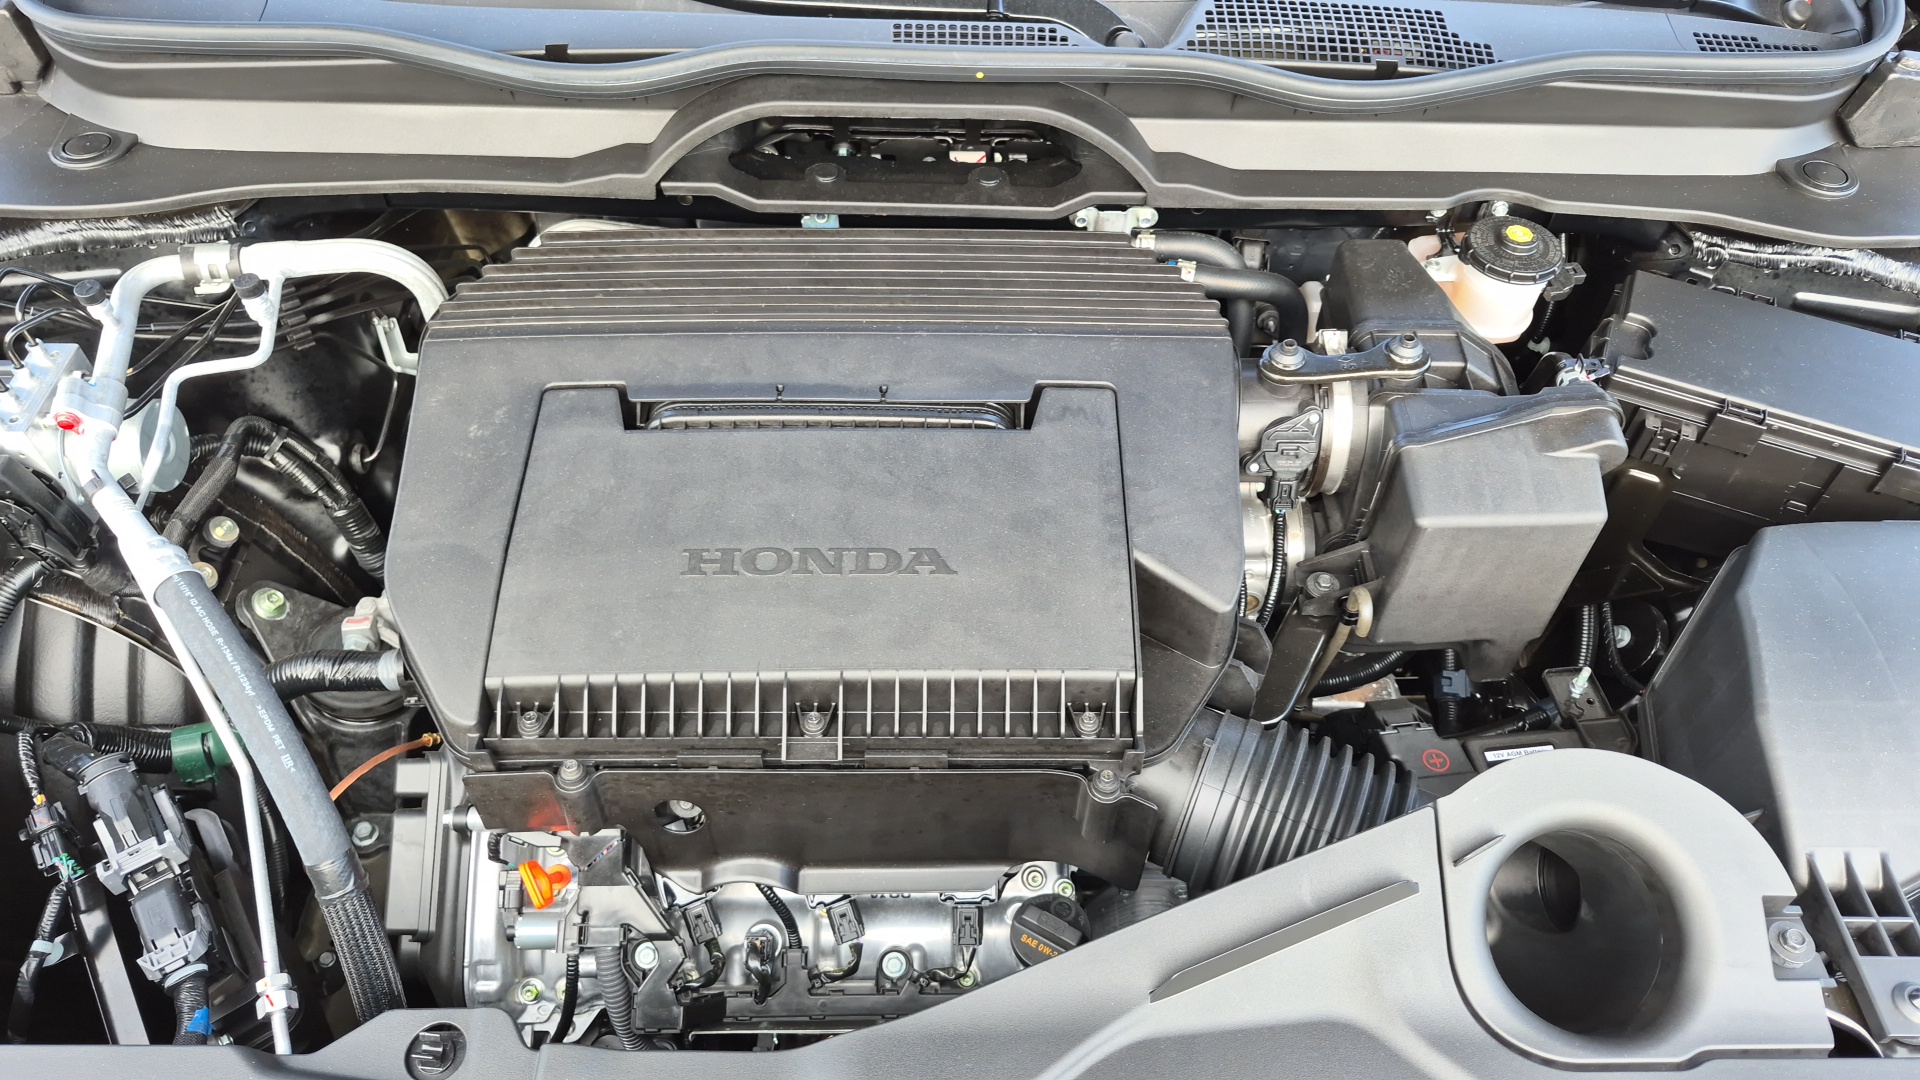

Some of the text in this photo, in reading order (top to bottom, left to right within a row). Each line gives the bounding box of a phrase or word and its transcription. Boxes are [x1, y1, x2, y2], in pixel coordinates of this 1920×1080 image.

[680, 546, 958, 576] HONDA
[178, 582, 194, 597] 11/16"
[190, 598, 198, 606] ID
[194, 606, 206, 617] A/C
[202, 616, 219, 636] HOSE
[216, 637, 234, 661] R-134a
[233, 665, 256, 696] R-1234yf
[272, 734, 286, 750] PET
[1020, 934, 1059, 957] SAE 0W-2
